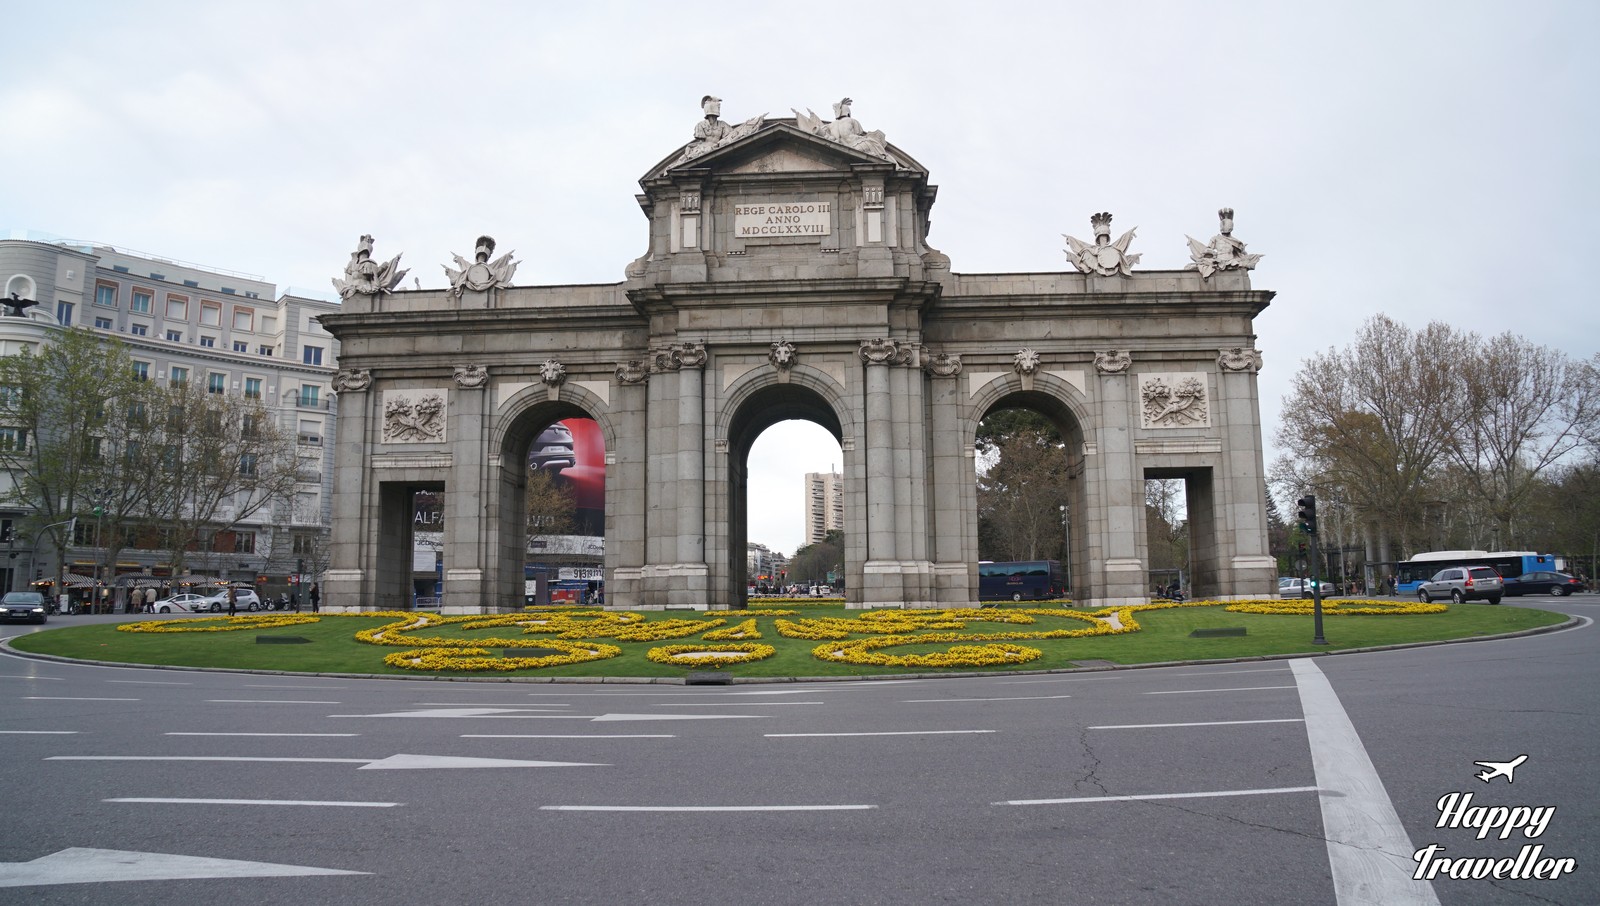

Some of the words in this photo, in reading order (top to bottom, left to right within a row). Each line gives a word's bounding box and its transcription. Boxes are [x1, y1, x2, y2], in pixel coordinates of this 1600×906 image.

[735, 206, 765, 215] REGE
[768, 206, 814, 214] CAROLO
[766, 216, 801, 224] ANNO
[742, 225, 824, 235] MDCCLXXVIII
